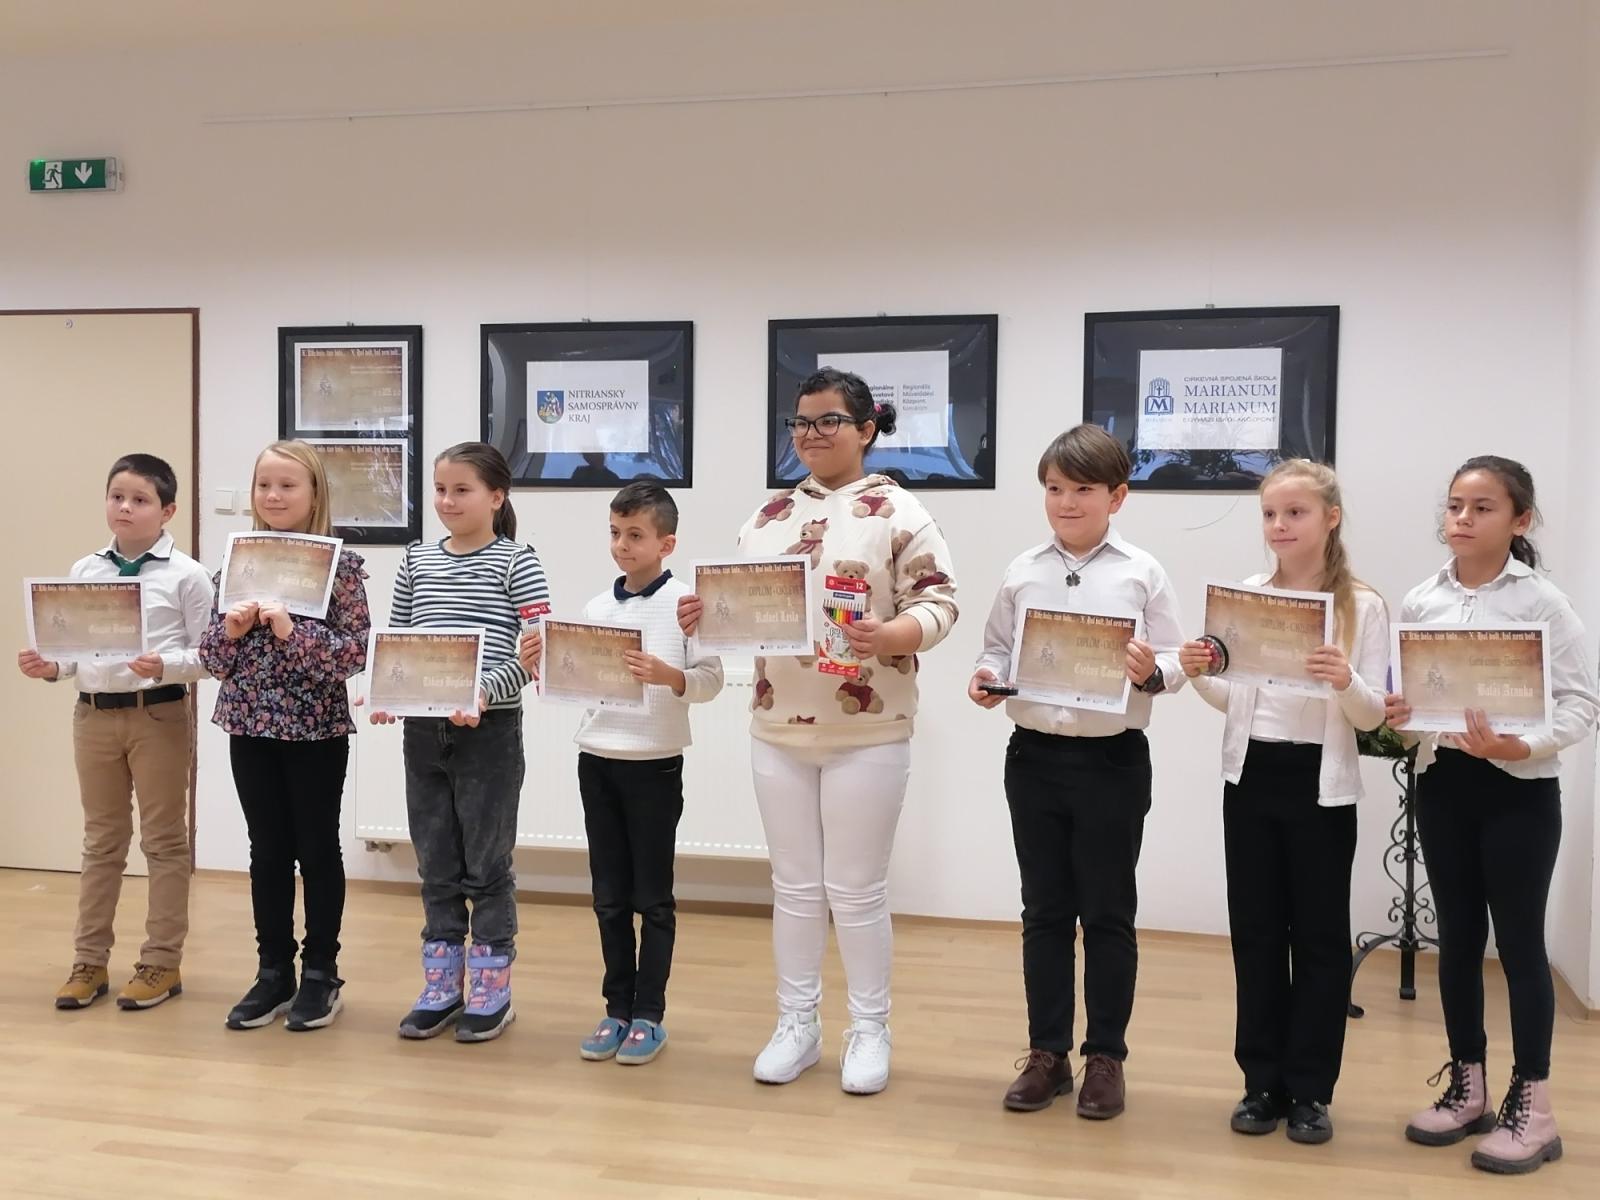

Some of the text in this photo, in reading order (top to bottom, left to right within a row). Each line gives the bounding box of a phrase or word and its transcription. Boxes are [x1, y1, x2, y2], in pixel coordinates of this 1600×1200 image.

[568, 389, 625, 399] NITRIANSKY
[1184, 384, 1277, 397] MARIANUM
[568, 401, 639, 411] SAMOSPRÁVNY
[1150, 398, 1168, 411] M
[1184, 401, 1276, 414] MARIANUM
[568, 414, 591, 424] KRAJ
[855, 582, 864, 590] 12
